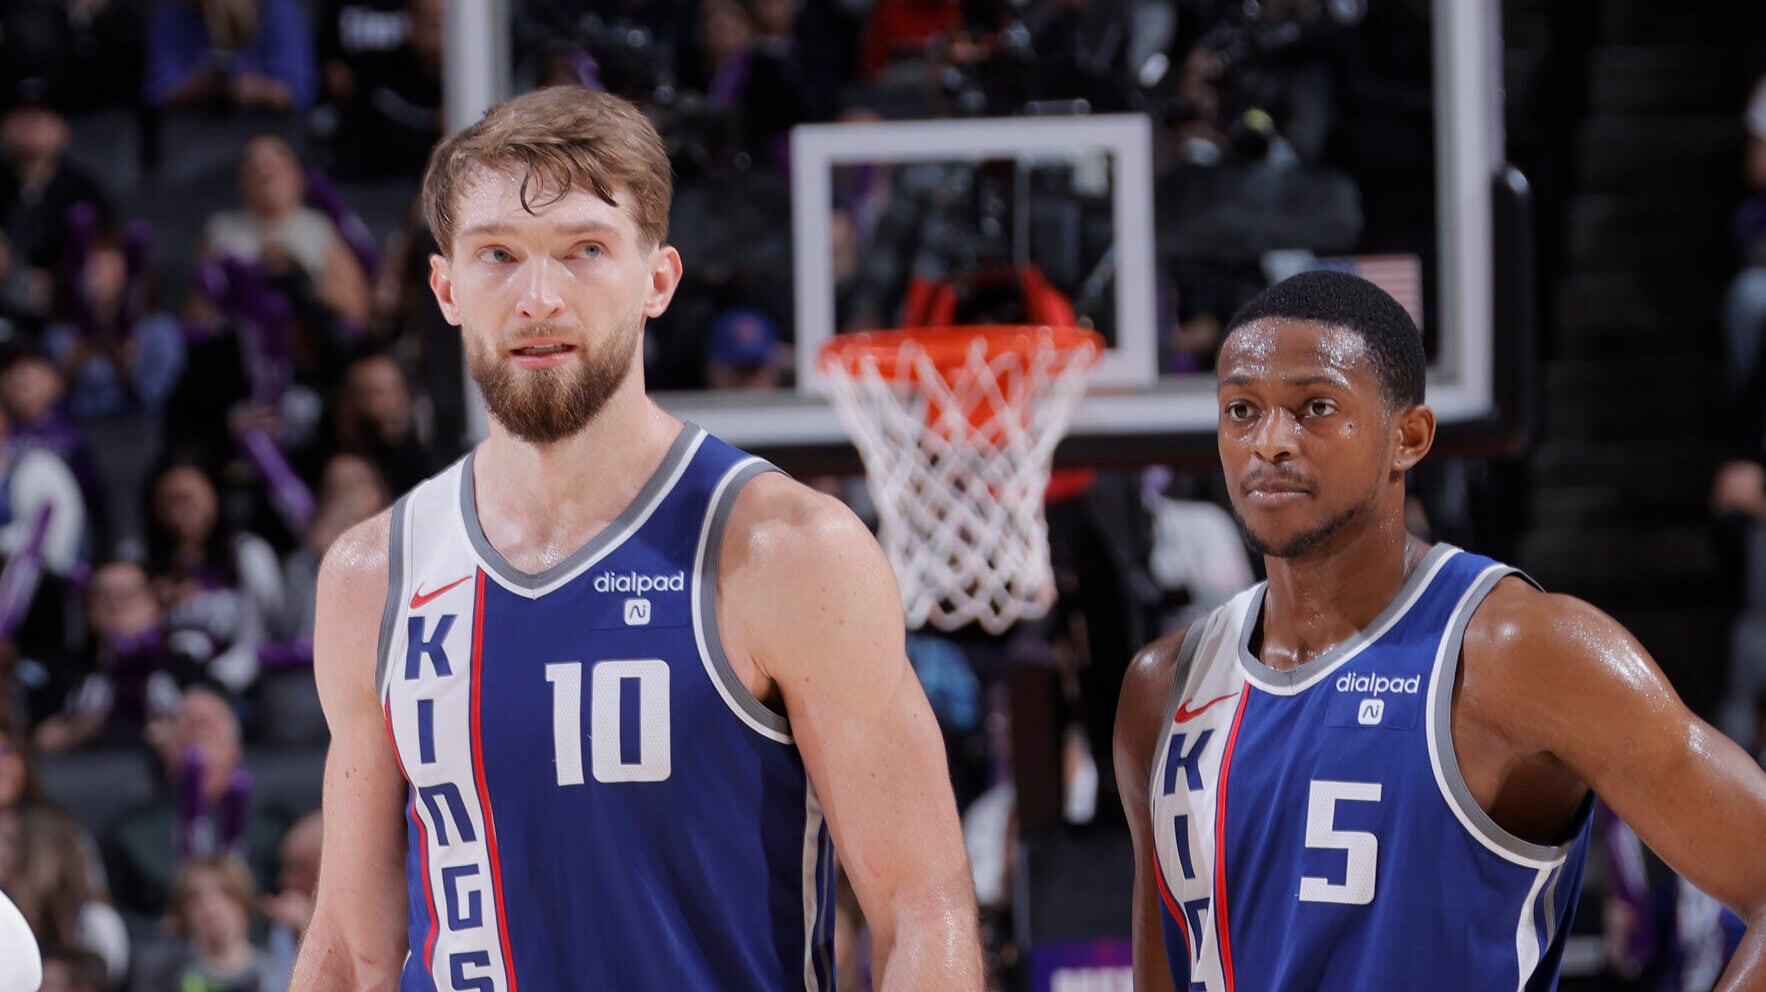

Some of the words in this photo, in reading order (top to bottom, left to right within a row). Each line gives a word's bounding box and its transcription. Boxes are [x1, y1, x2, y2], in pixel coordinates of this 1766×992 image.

[594, 571, 684, 596] dialpad
[1336, 671, 1420, 697] dialpad
[545, 659, 672, 786] 10
[1299, 779, 1383, 905] 5
